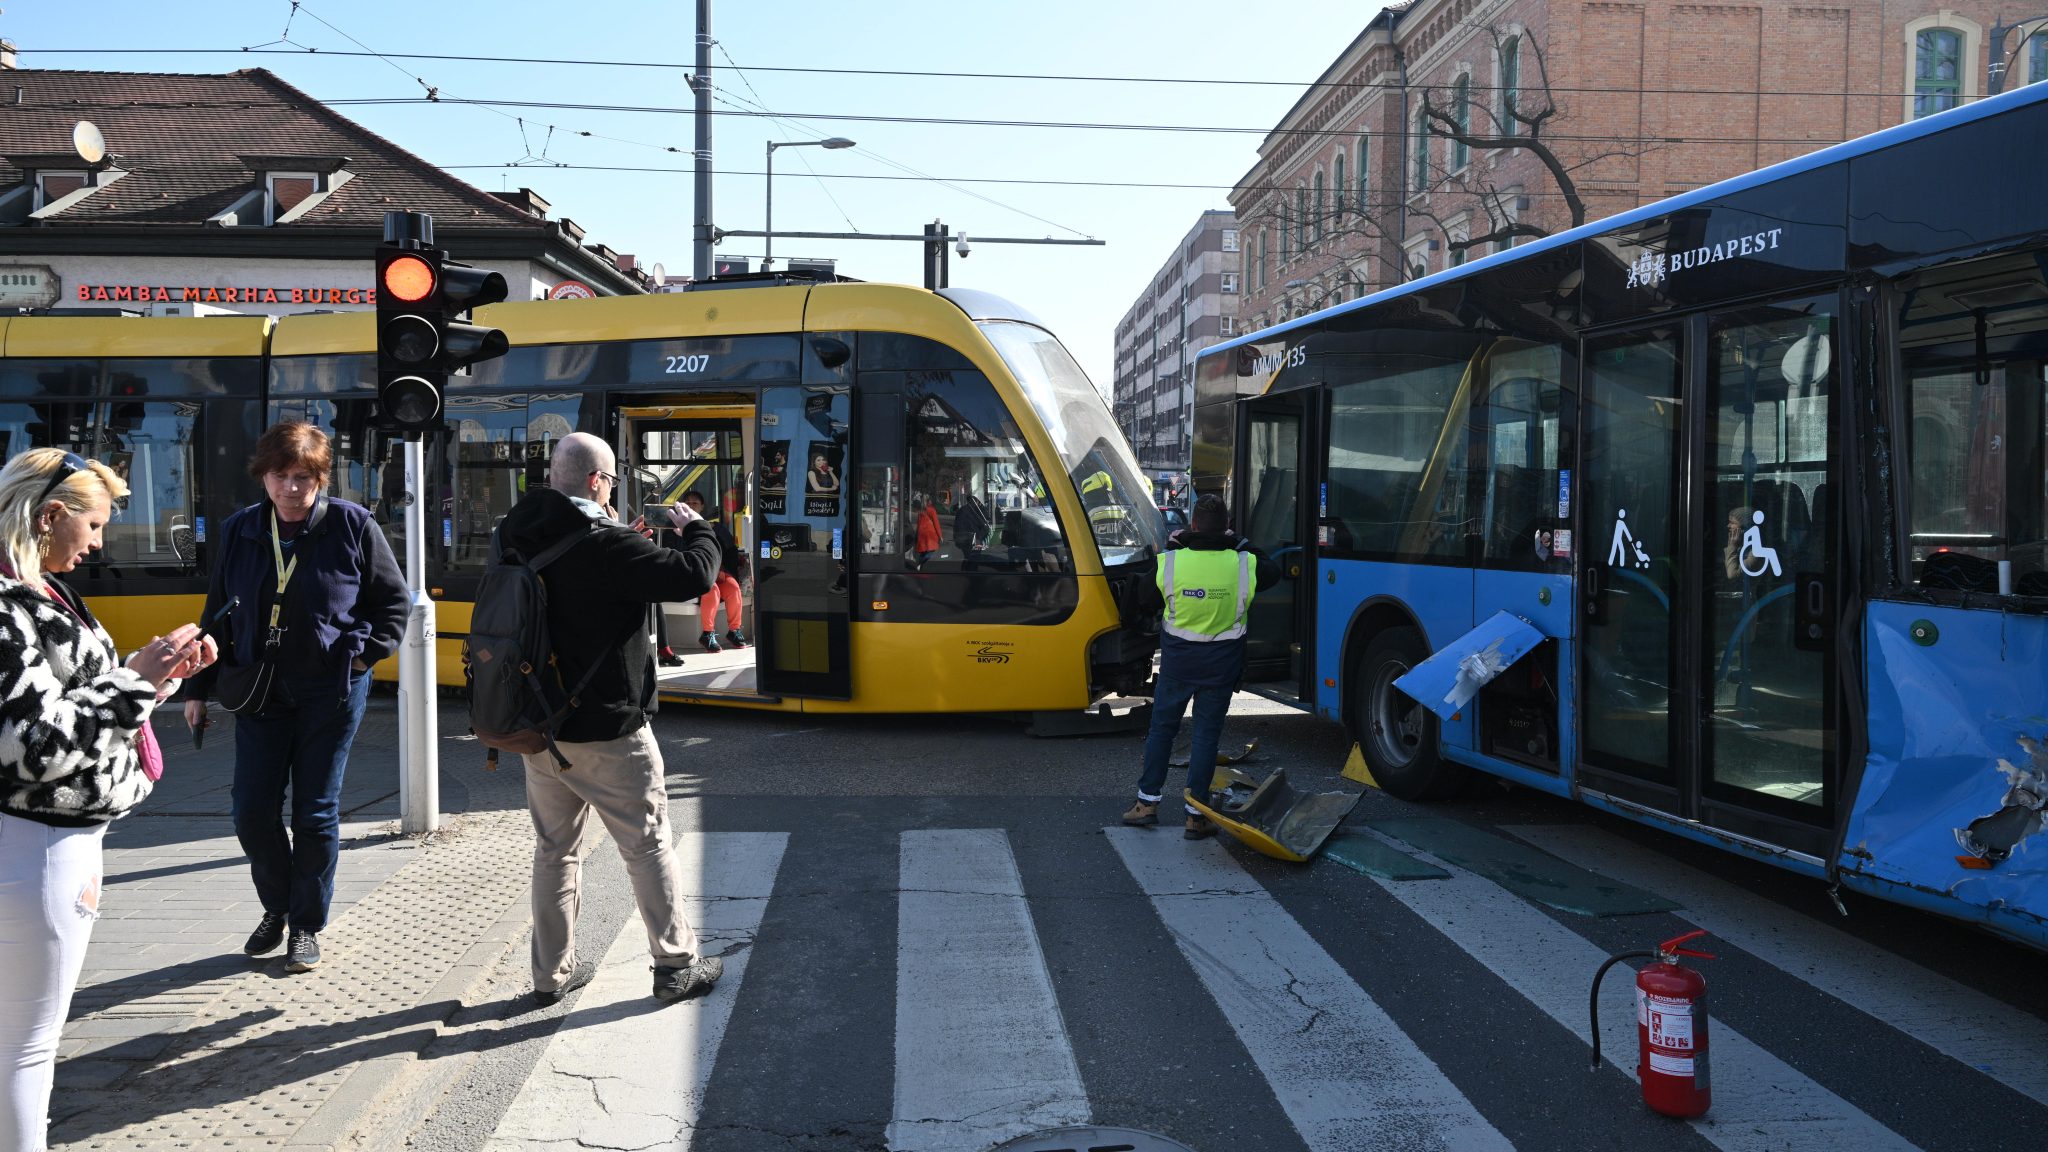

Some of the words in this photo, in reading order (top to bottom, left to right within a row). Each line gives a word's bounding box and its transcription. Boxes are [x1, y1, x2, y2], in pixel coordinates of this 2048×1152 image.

[1670, 228, 1782, 272] BUDAPEST
[78, 285, 170, 301] BAMBA
[183, 287, 278, 303] MARHA
[291, 288, 377, 304] BURGE
[665, 354, 710, 374] 2207
